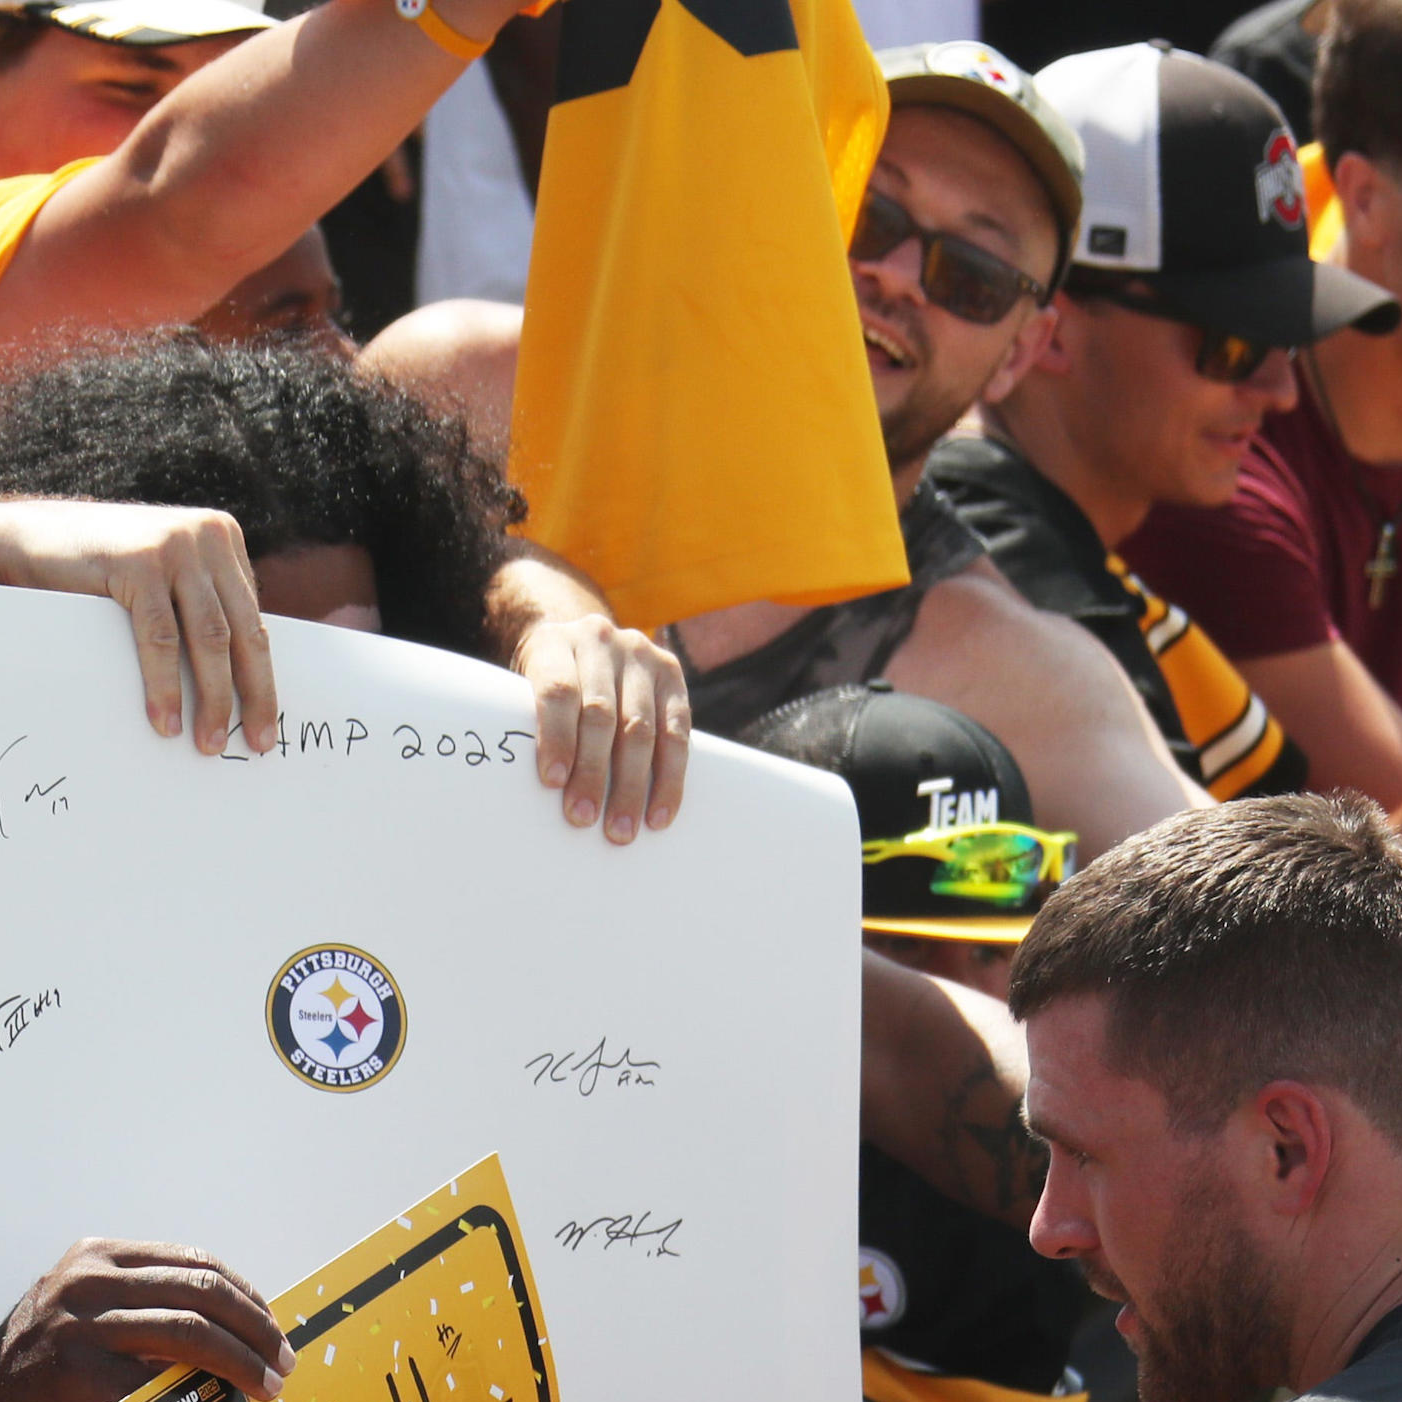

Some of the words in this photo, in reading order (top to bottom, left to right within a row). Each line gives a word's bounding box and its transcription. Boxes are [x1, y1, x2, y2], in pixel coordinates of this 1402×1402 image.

[393, 724, 536, 766] 2025
[916, 776, 998, 829] TEAM
[279, 951, 394, 1001] PITTSBURGH
[298, 1009, 333, 1022] Steelers
[290, 1048, 384, 1086] STEELERS
[198, 1377, 221, 1402] 2025
